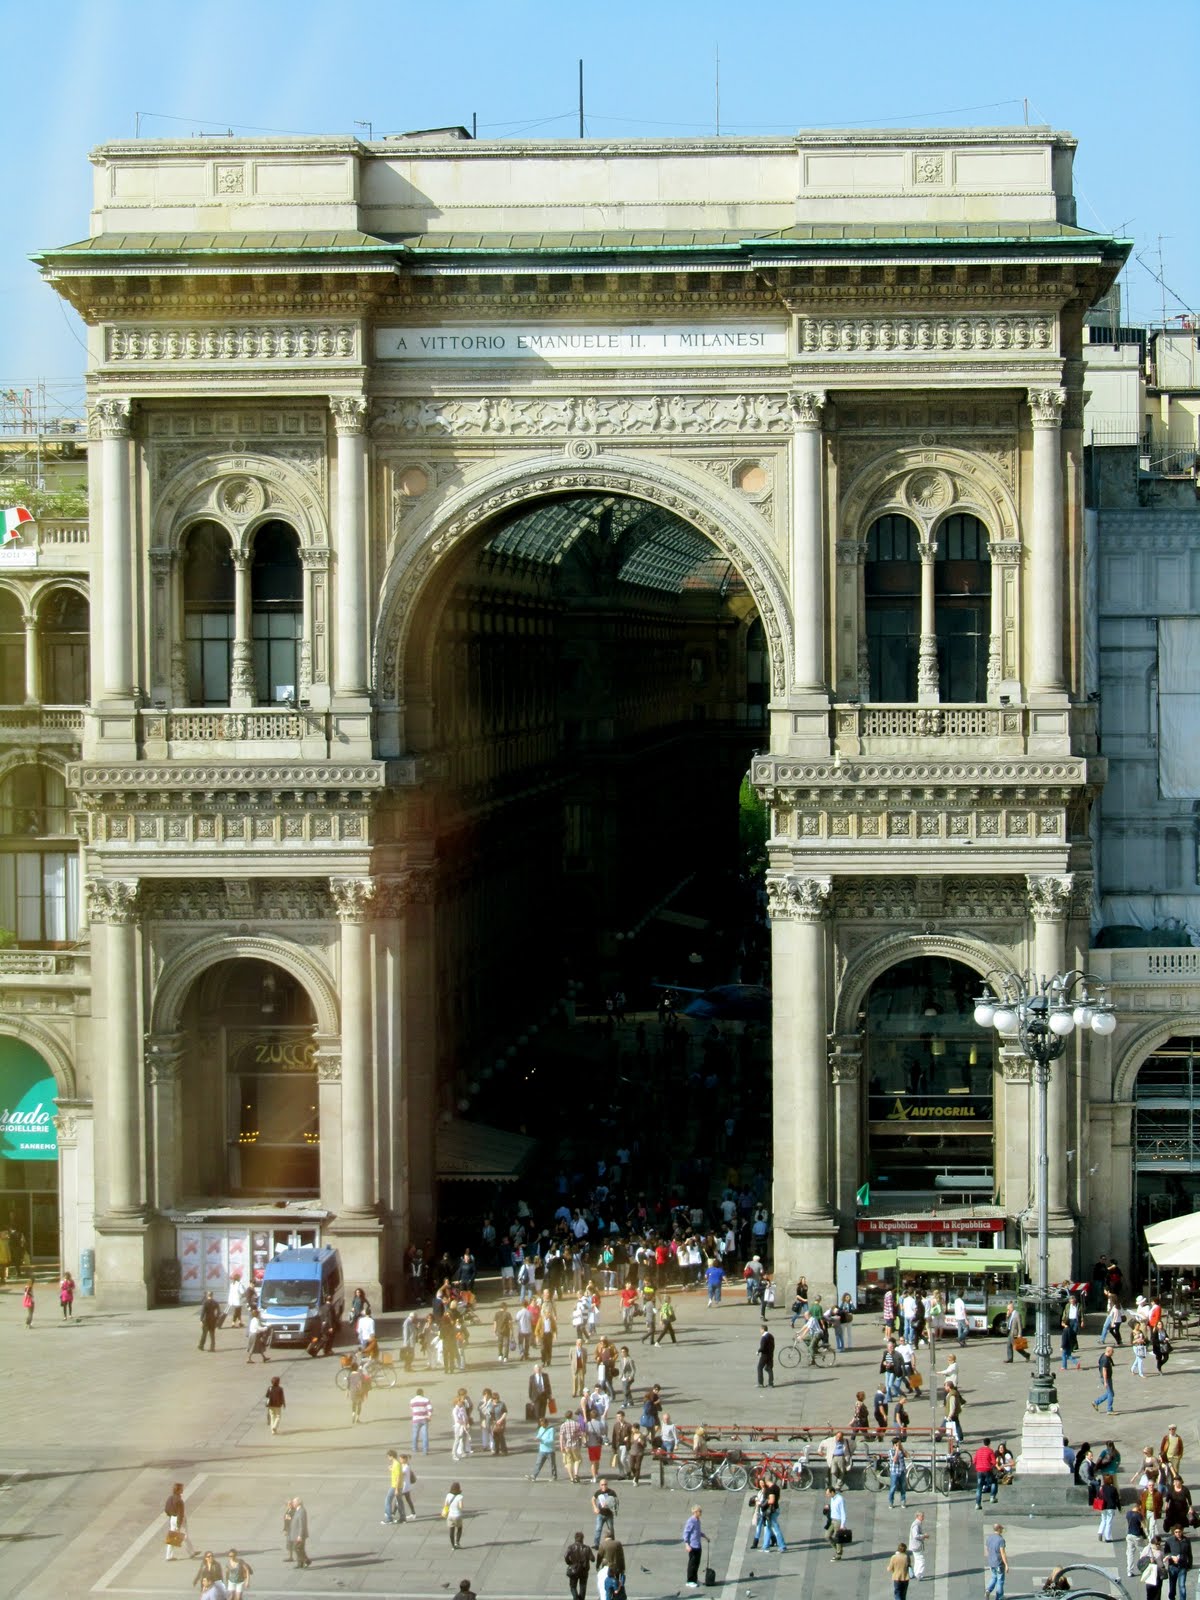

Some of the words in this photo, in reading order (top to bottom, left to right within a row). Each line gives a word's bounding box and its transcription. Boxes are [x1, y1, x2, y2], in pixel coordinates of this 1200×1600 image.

[396, 336, 408, 350] A
[420, 336, 506, 350] VITTORIO
[517, 334, 619, 349] EMANUELE
[630, 334, 647, 348] II.
[679, 333, 765, 347] MILANESI
[910, 1106, 976, 1117] AUTOGRILL
[870, 1221, 877, 1229] la
[878, 1221, 918, 1231] Repubblica
[942, 1220, 950, 1229] la
[951, 1220, 991, 1231] Repubblica
